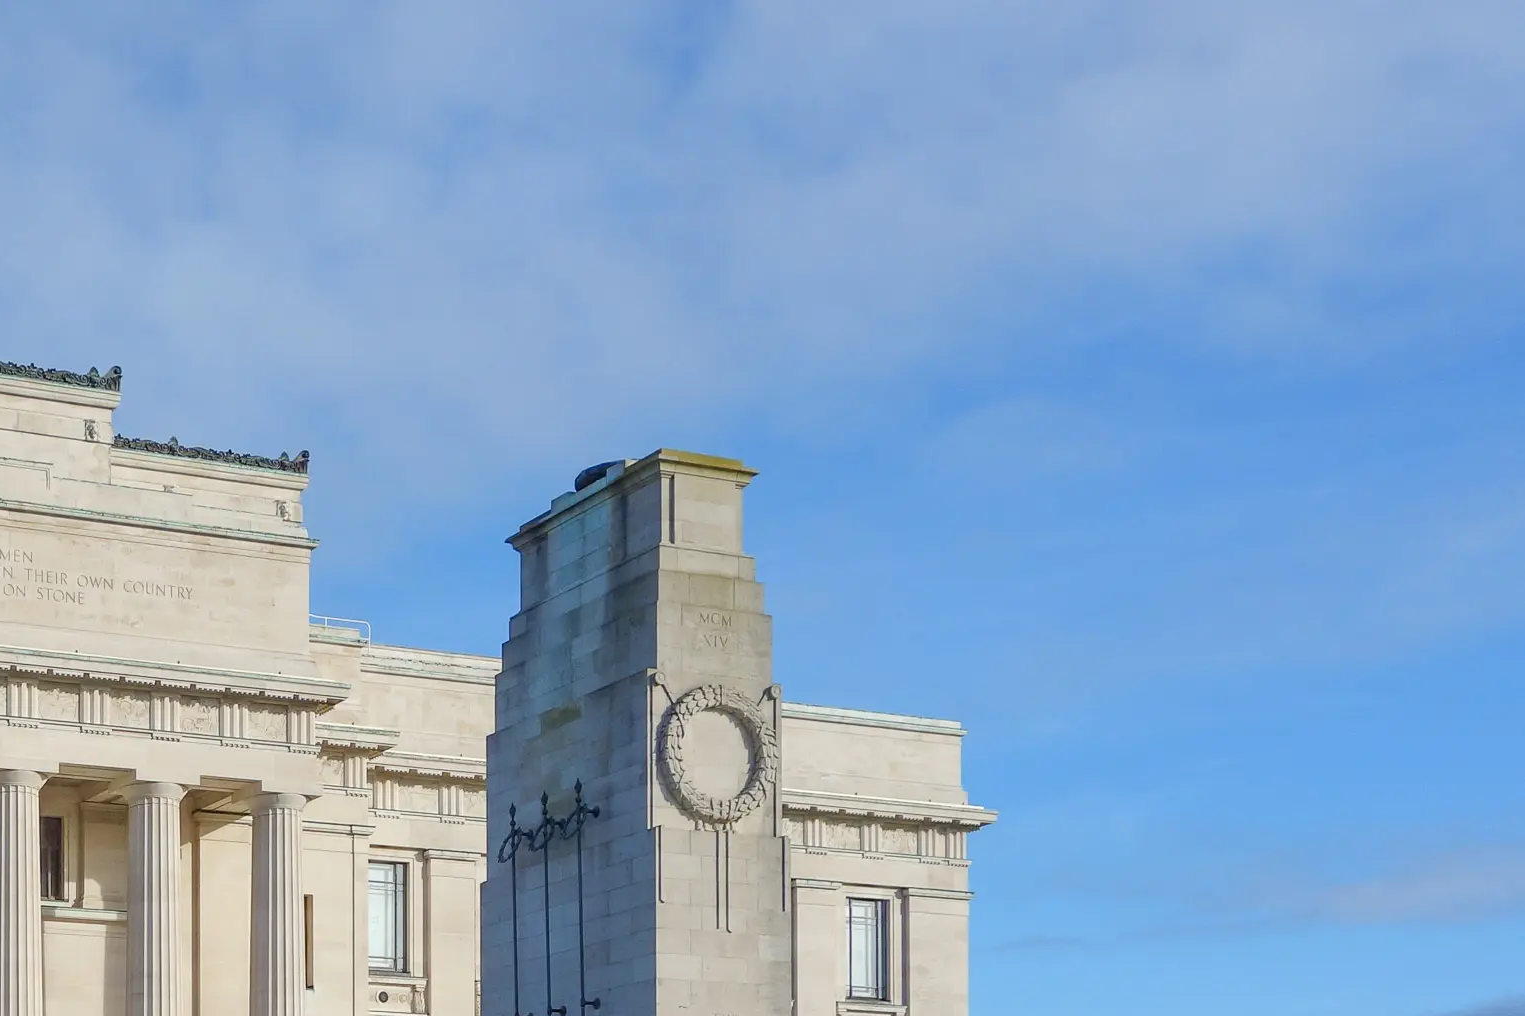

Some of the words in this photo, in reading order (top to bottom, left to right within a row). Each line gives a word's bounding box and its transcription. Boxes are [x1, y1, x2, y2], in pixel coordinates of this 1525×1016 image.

[0, 548, 33, 563] MEN
[24, 567, 68, 586] THEIR
[76, 574, 115, 590] OWN
[123, 580, 193, 600] COUNTRY
[3, 583, 26, 597] ON
[36, 587, 86, 605] STONE
[699, 612, 732, 627] MCM
[703, 634, 728, 648] XIV
